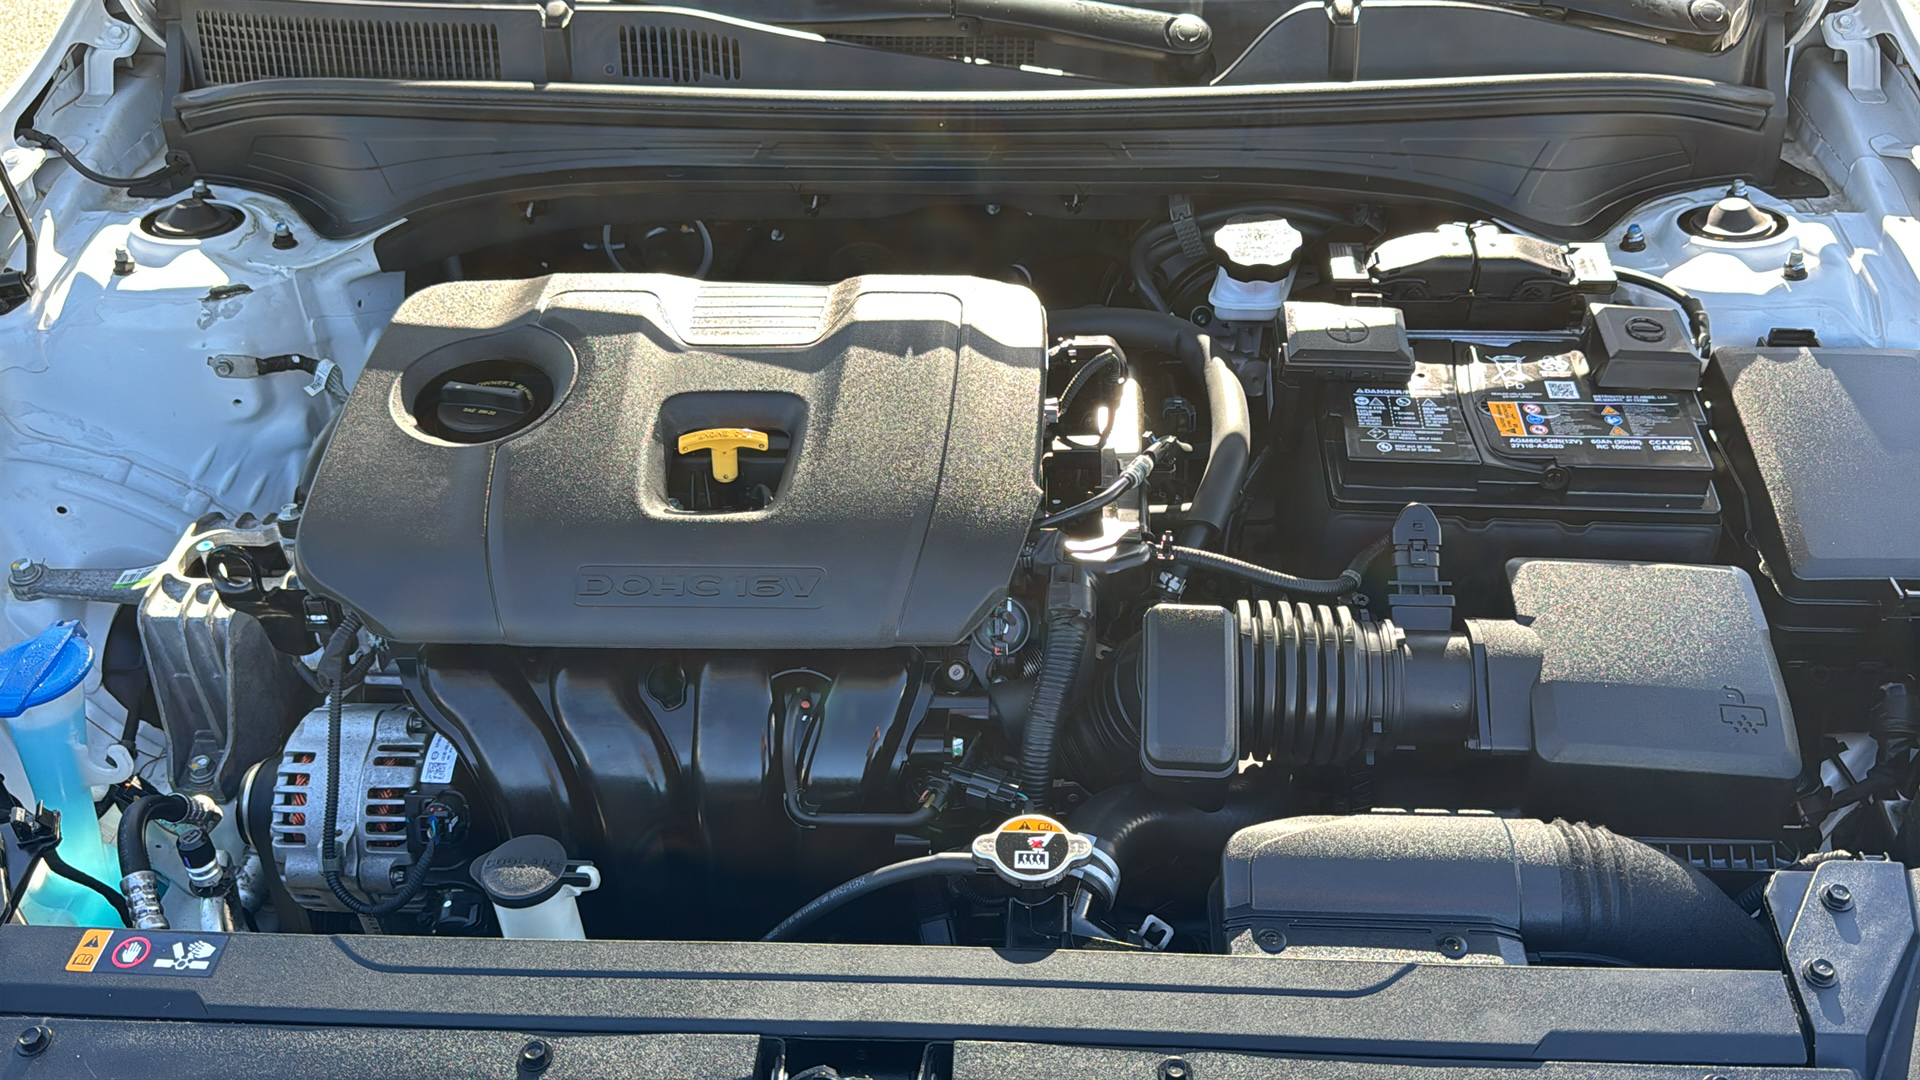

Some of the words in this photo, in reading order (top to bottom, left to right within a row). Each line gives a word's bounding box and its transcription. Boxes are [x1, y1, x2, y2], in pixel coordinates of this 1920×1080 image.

[1504, 380, 1525, 389] Pb
[578, 573, 723, 597] DOHC
[736, 574, 821, 598] 16V
